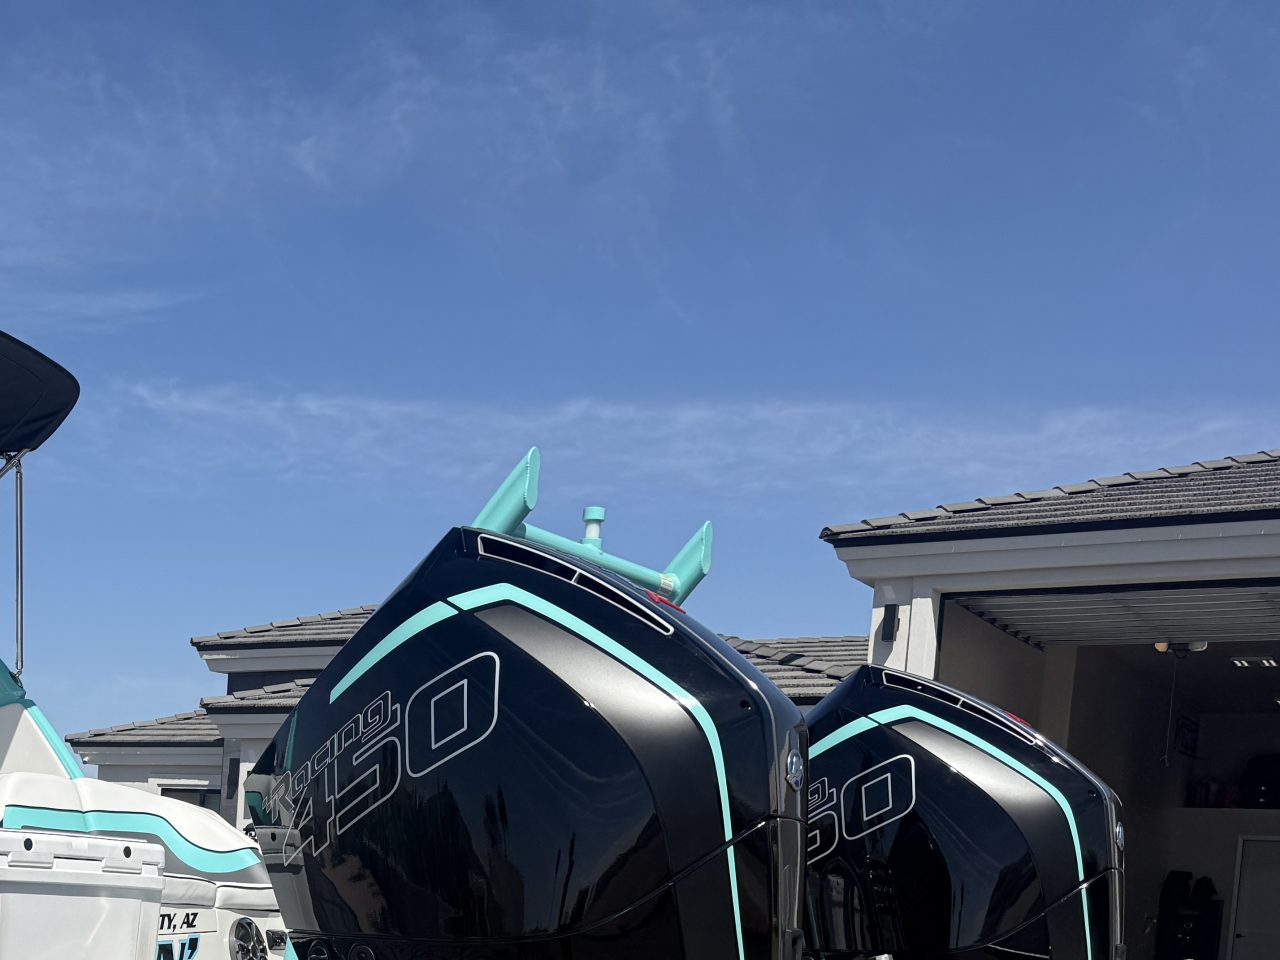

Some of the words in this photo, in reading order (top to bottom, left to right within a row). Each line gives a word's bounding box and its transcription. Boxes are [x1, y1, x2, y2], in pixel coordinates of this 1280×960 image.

[282, 650, 501, 868] 450
[806, 753, 917, 866] 50
[159, 912, 177, 932] TY,
[180, 911, 199, 930] AZ
